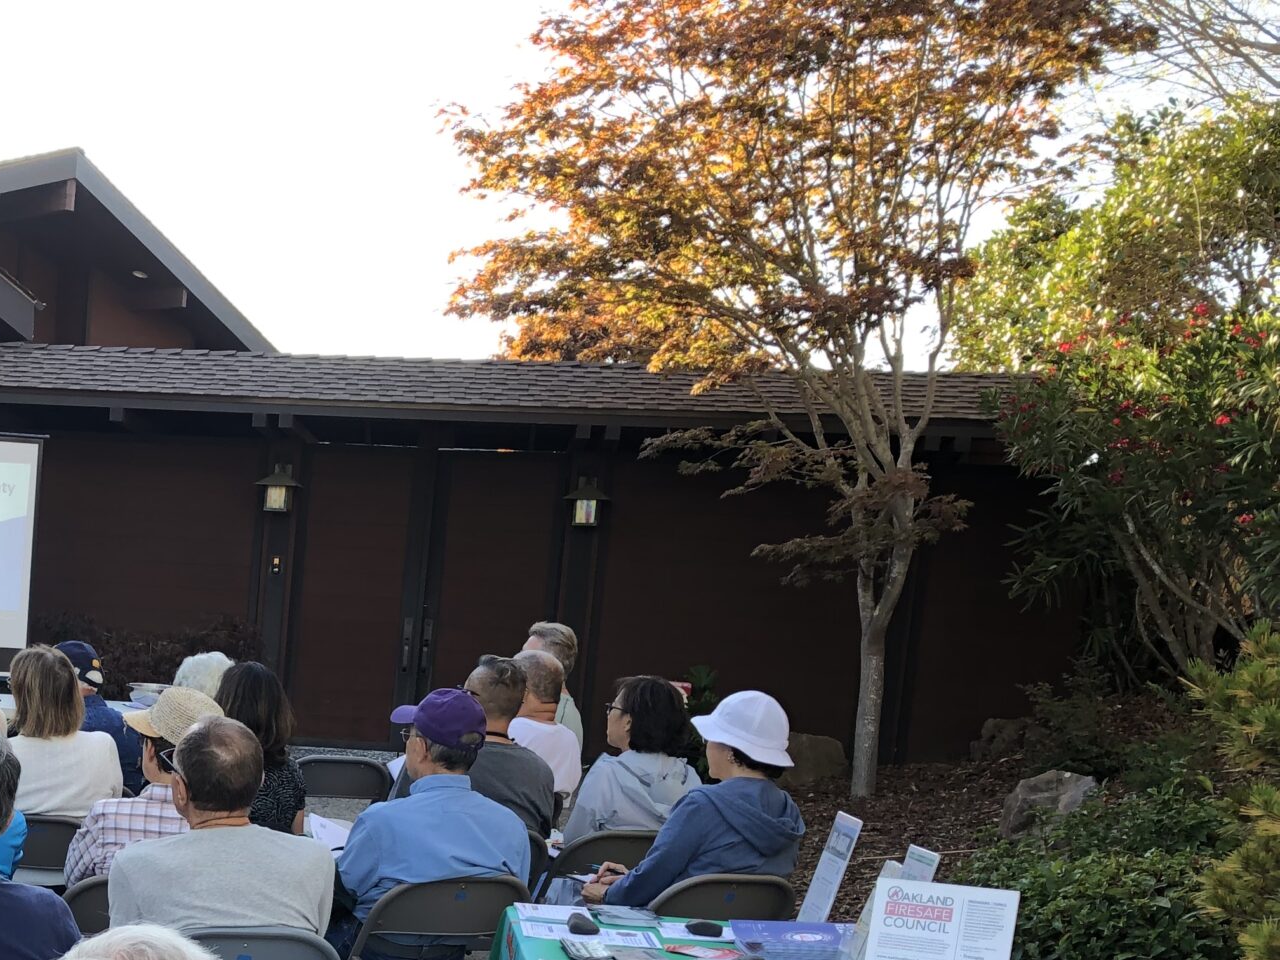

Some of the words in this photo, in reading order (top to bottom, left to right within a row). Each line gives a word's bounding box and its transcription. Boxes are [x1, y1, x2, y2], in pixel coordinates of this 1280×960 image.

[887, 886, 954, 907] OAKLAND
[885, 902, 952, 921] FIRESAFE
[883, 916, 950, 934] COUNCIL
